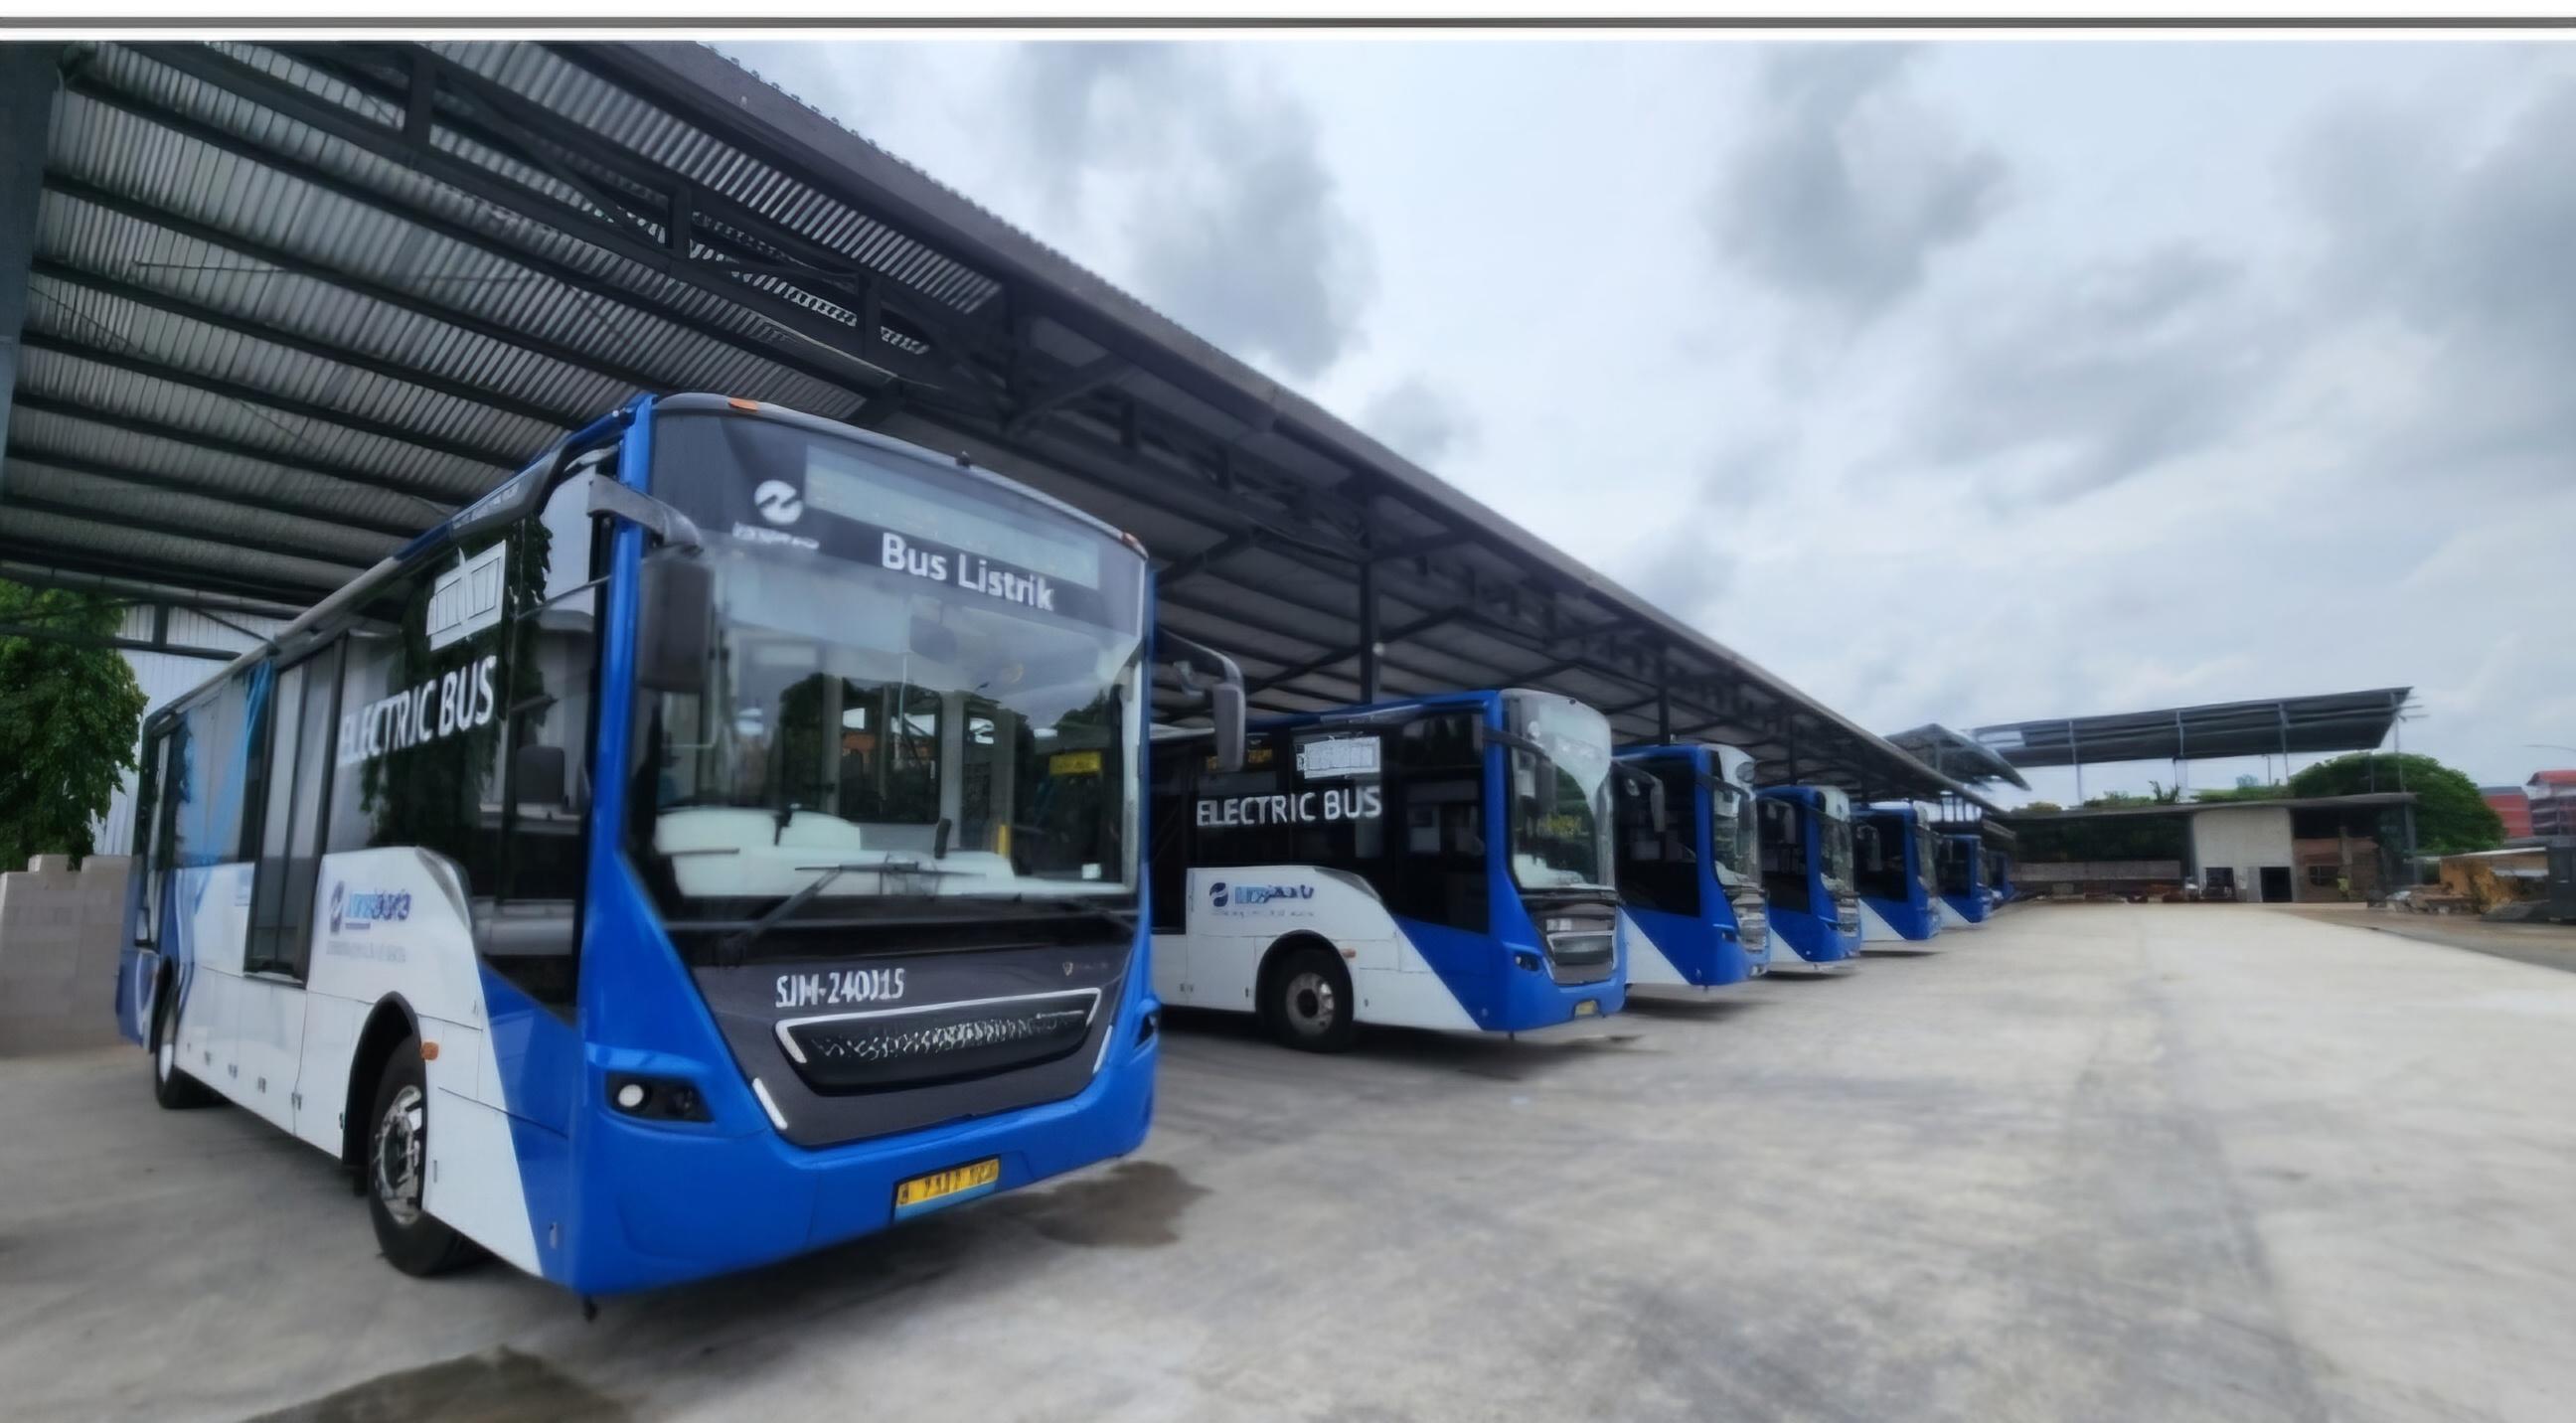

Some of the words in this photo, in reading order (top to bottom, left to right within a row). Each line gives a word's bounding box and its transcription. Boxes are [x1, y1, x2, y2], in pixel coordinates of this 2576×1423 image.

[882, 532, 948, 581] Bus
[957, 553, 1055, 612] Listrik
[338, 679, 437, 765] ELECTRIC
[437, 654, 498, 737] BUS
[1196, 792, 1316, 827] ELECTRIC
[1323, 784, 1383, 821] BUS
